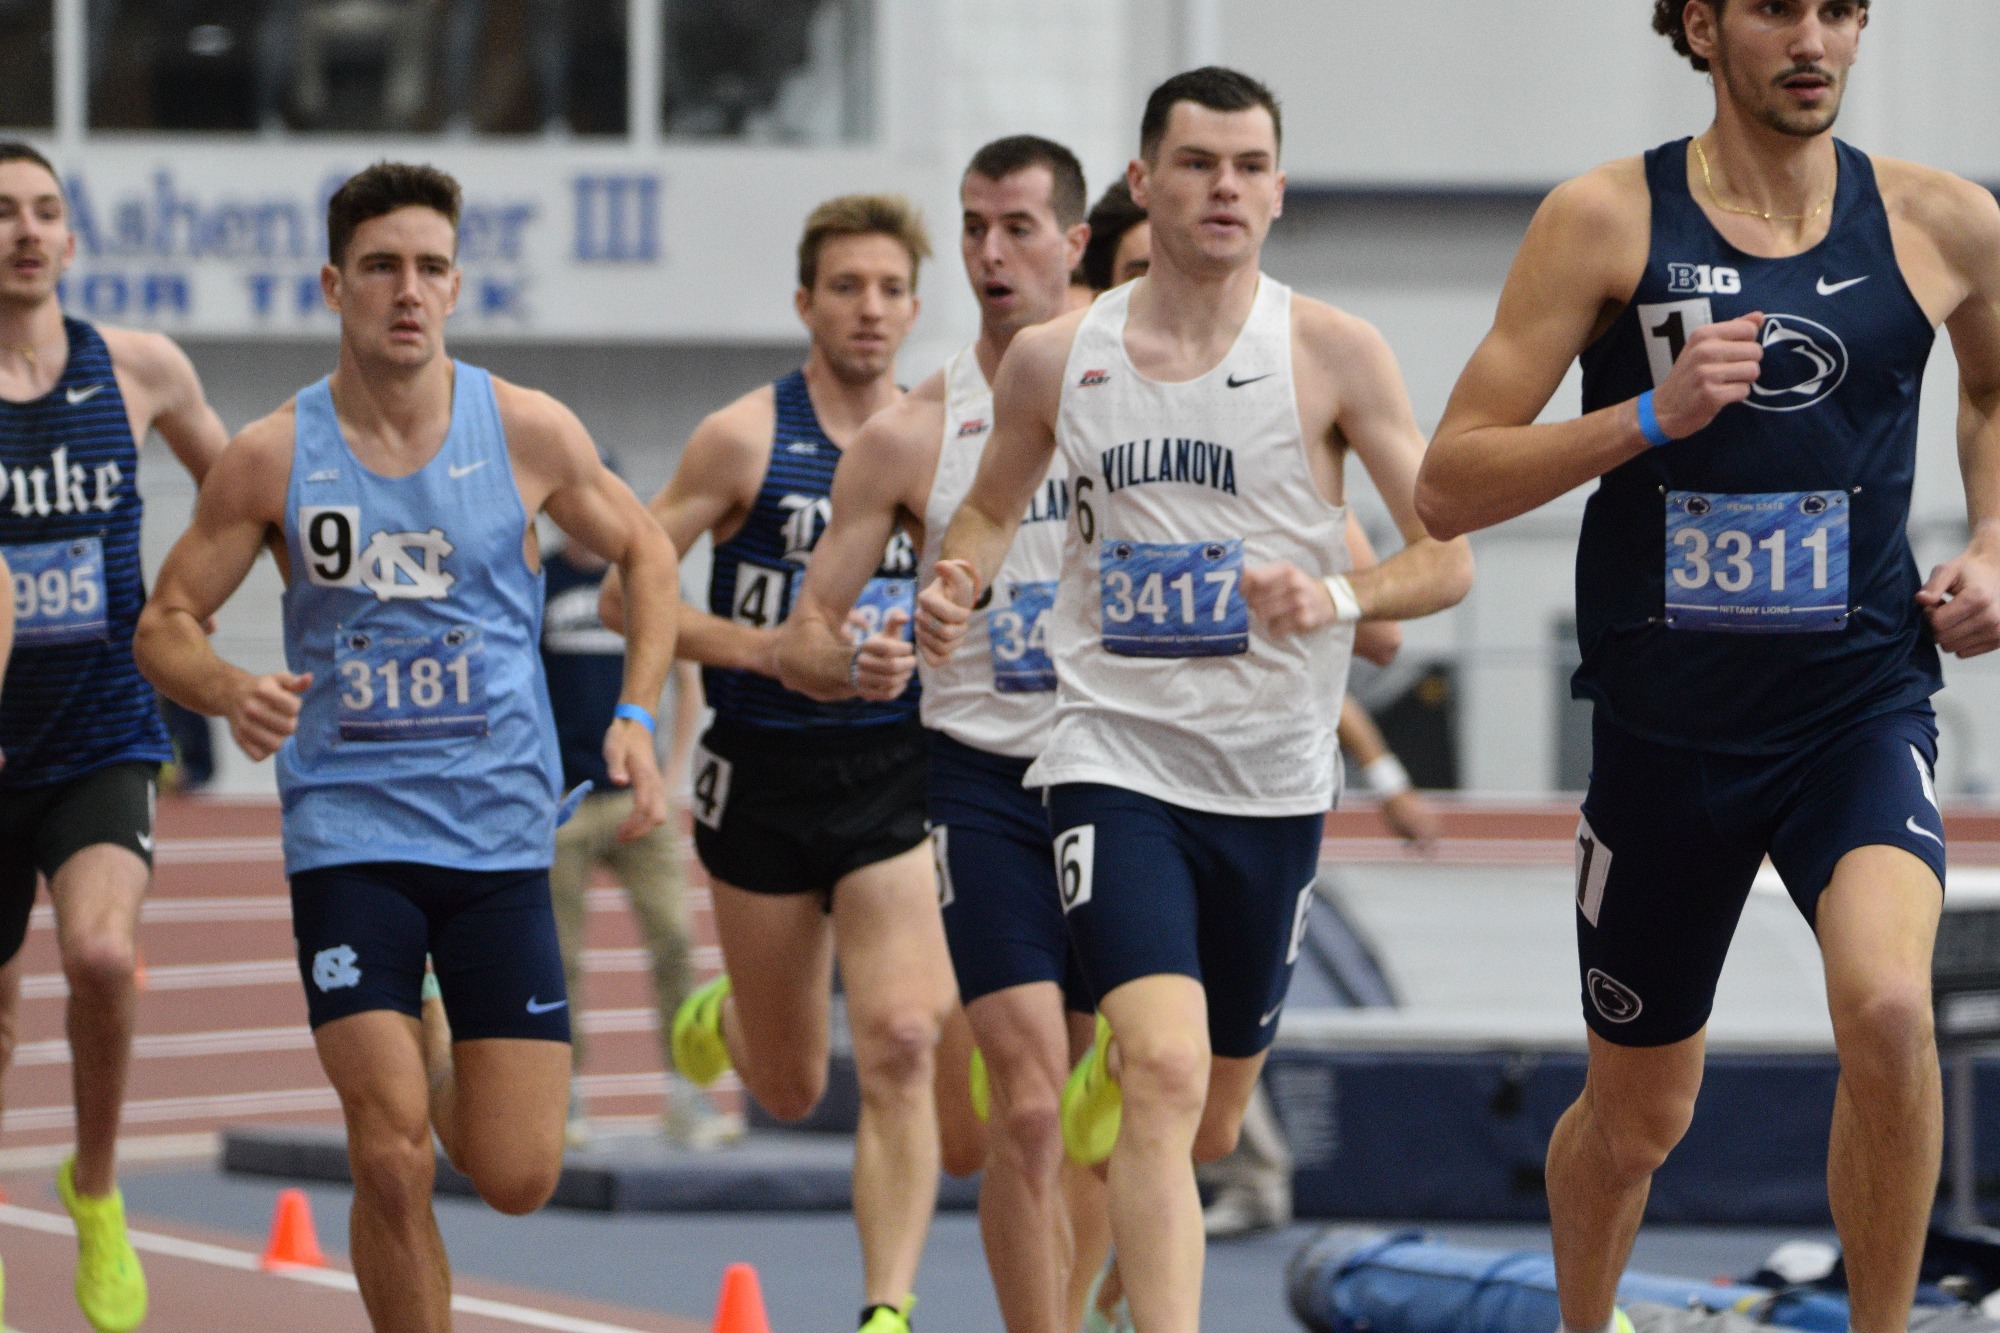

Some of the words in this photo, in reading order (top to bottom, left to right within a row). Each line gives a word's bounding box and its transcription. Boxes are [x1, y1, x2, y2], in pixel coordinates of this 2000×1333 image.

[1102, 438, 1237, 496] VILLANOVA
[1075, 475, 1094, 544] 6
[309, 511, 351, 580] 9
[1672, 527, 1827, 592] 3311
[14, 566, 97, 619] 995
[740, 574, 768, 627] 4
[1105, 570, 1237, 624] 3417
[1719, 606, 1759, 614] NITTANY
[1761, 606, 1790, 614] LIONS
[995, 609, 1051, 661] 34
[341, 654, 471, 710] 3181
[697, 761, 719, 817] 4
[1061, 834, 1081, 905] 6
[1579, 836, 1595, 907] 1
